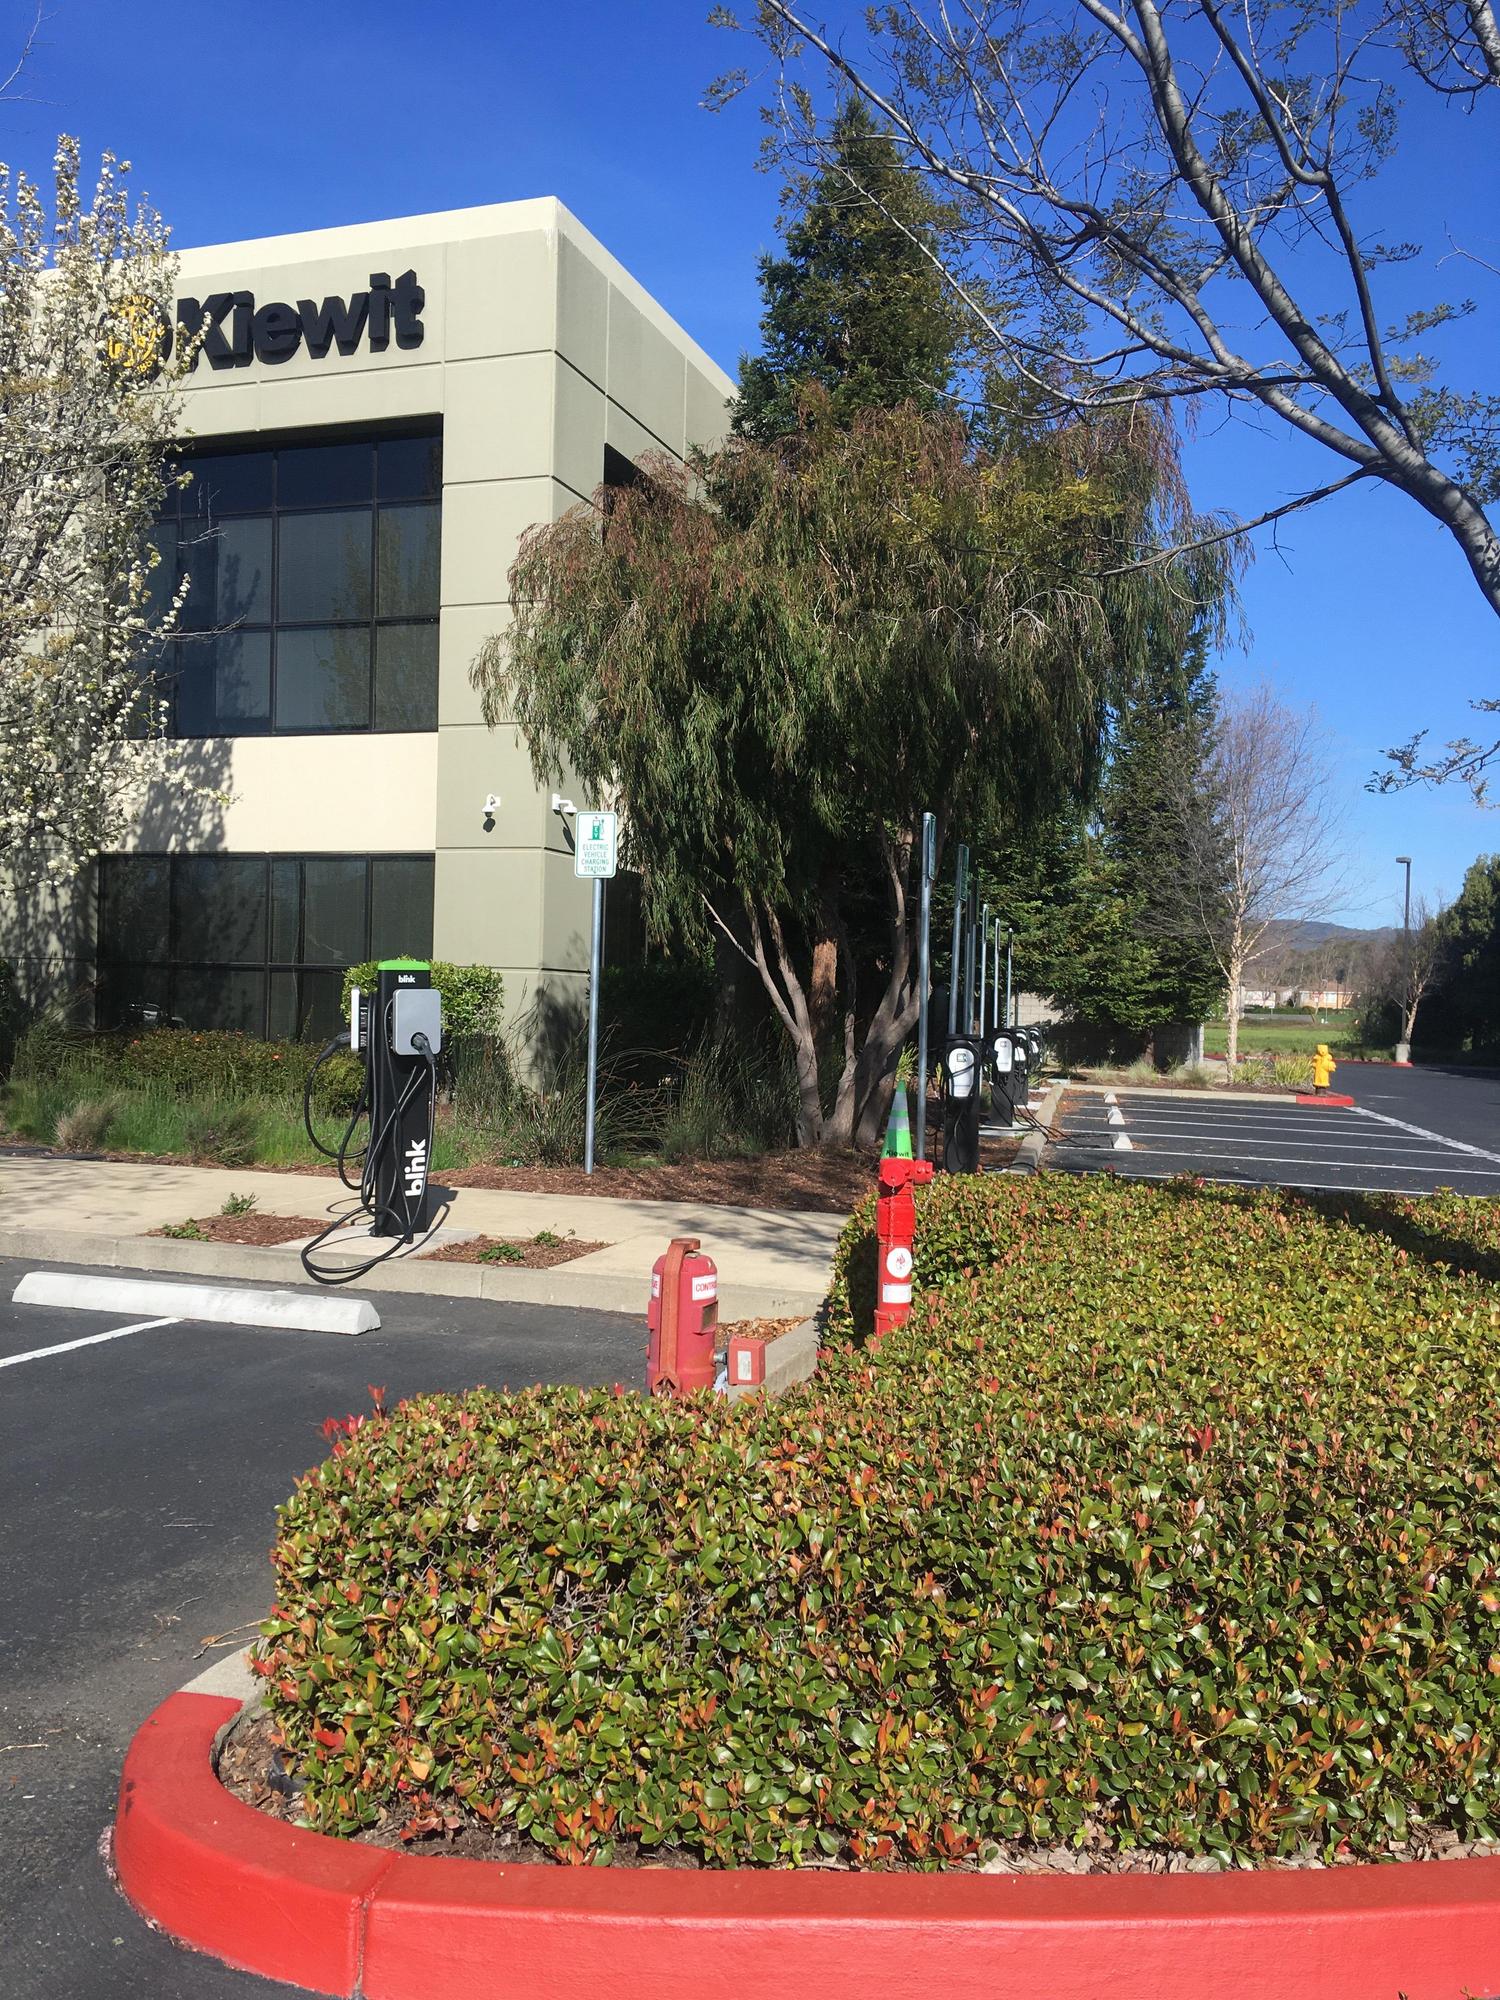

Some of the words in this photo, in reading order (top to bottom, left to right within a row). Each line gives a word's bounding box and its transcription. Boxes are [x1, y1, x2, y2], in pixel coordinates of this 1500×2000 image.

[176, 269, 425, 373] Kiewit
[398, 974, 416, 983] blink
[404, 1138, 426, 1197] blink
